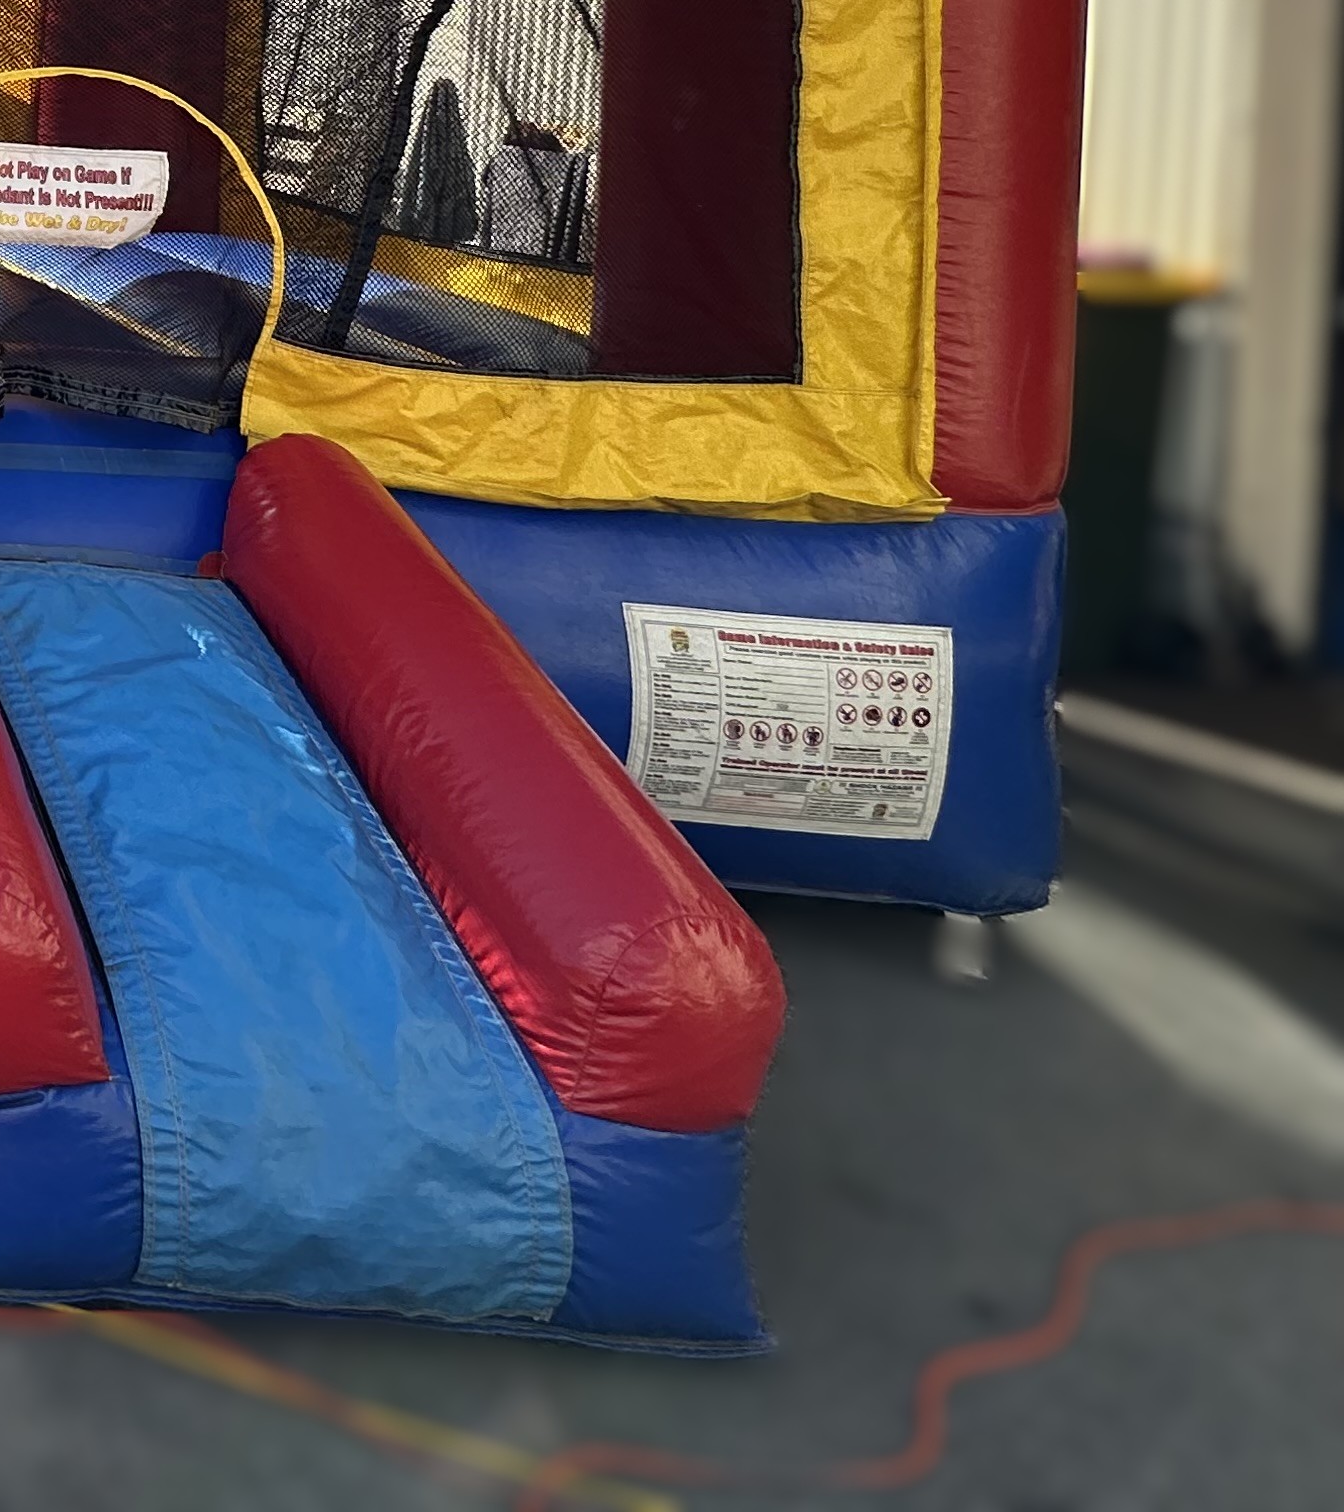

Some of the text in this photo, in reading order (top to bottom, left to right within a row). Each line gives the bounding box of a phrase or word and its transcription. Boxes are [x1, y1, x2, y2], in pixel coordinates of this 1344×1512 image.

[17, 161, 49, 185] Play
[52, 166, 71, 182] on
[75, 165, 117, 185] Game
[56, 189, 81, 209] Not
[25, 211, 63, 230] Wet
[66, 215, 83, 231] &
[85, 215, 128, 235] Dry!
